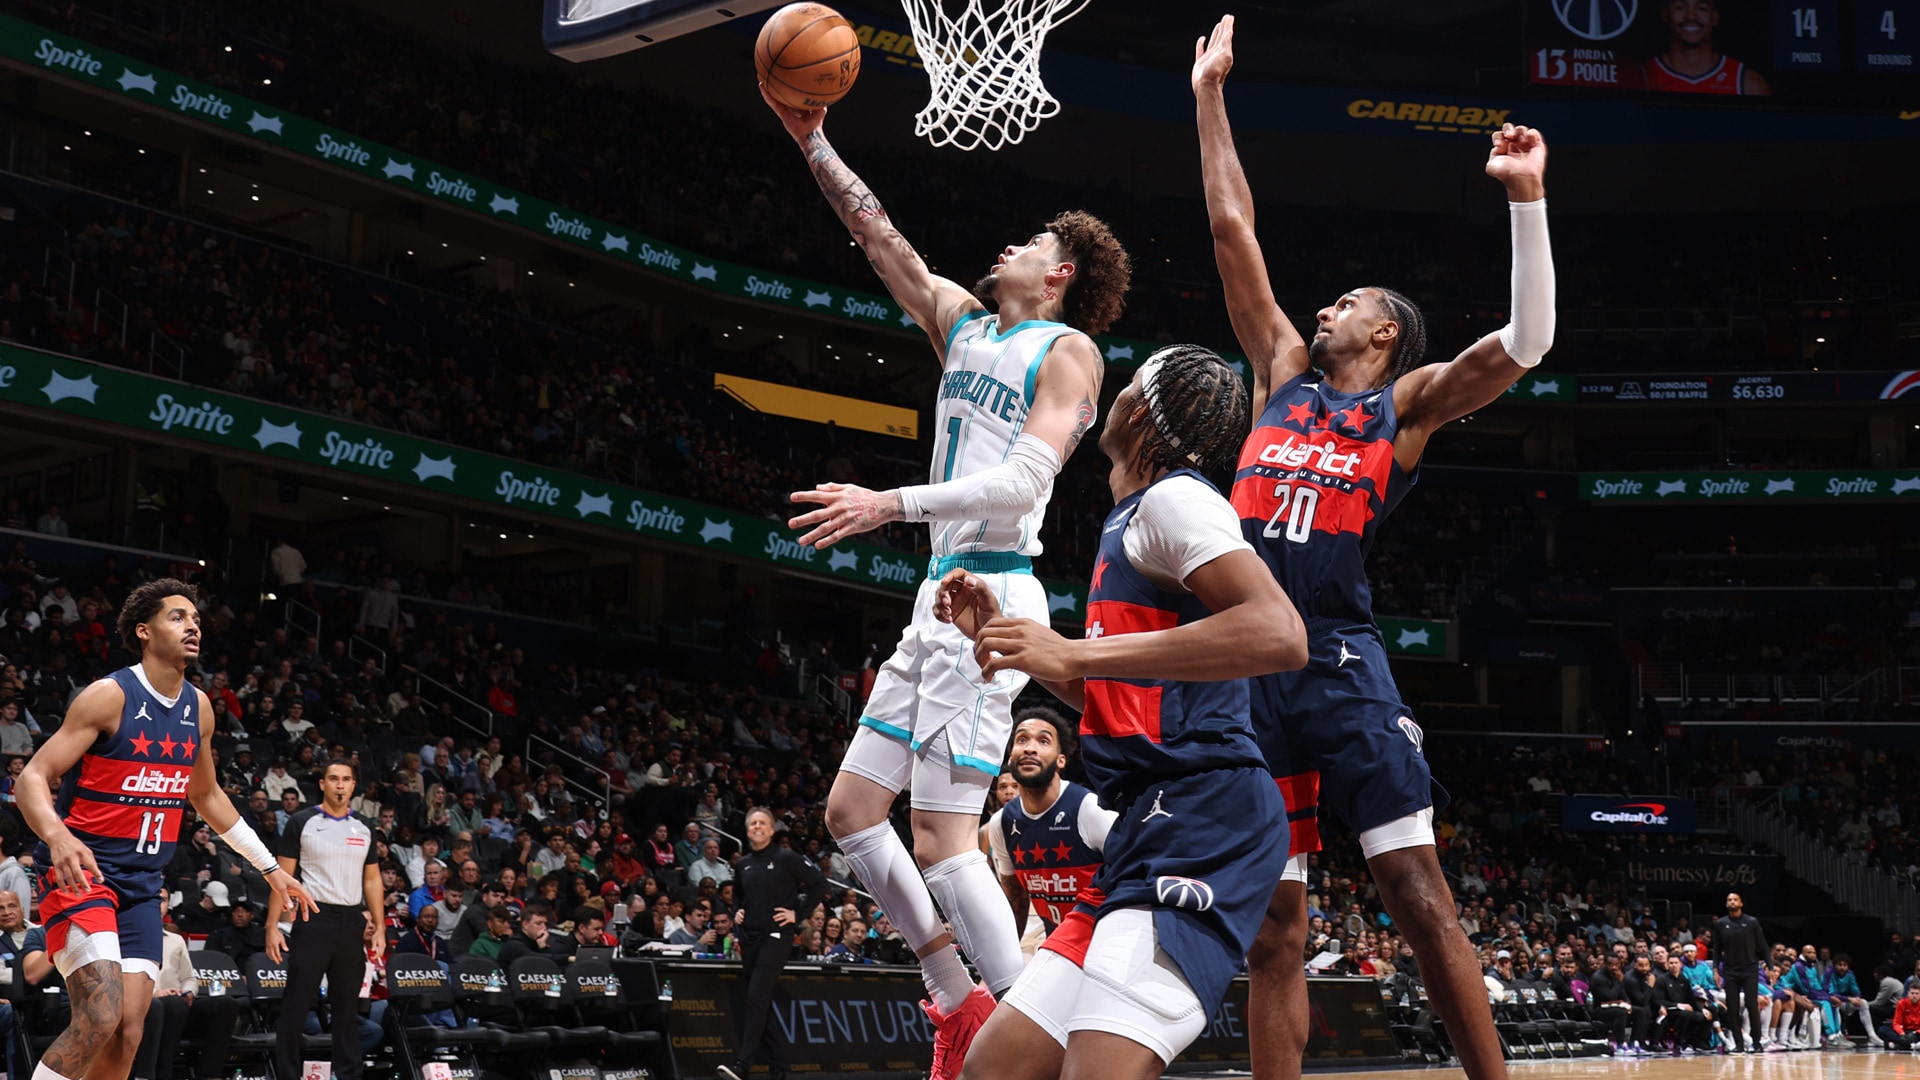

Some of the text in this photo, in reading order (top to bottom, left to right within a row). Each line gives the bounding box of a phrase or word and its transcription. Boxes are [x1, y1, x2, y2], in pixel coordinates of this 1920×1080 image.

[1792, 8, 1819, 38] 14
[1880, 10, 1897, 40] 4
[34, 38, 102, 76] Sprite
[1536, 48, 1568, 80] 13
[1573, 48, 1615, 60] JORDAN
[1792, 51, 1823, 63] POINTS
[1867, 53, 1912, 66] REBOUNDS
[1573, 64, 1618, 83] POOLE
[171, 85, 232, 120] Sprite
[315, 133, 370, 166] Sprite
[426, 171, 477, 202] Sprite
[545, 211, 592, 241] Sprite
[638, 243, 681, 271] Sprite
[743, 275, 793, 300] Sprite
[842, 296, 888, 320] Sprite
[940, 370, 1019, 423] CHARLOTTE
[1650, 381, 1707, 389] FOUNDATION
[1679, 390, 1708, 399] RAFFLE
[1732, 385, 1784, 400] $6,630
[149, 393, 234, 430] Sprite
[319, 430, 394, 470] Sprite
[943, 416, 962, 482] 1
[495, 470, 561, 506] Sprite
[1592, 479, 1643, 498] Sprite
[1699, 478, 1750, 498] Sprite
[1825, 477, 1878, 497] Sprite
[626, 500, 685, 533] Sprite
[1262, 483, 1318, 544] 20
[868, 554, 916, 584] Sprite
[121, 765, 191, 793] district
[136, 811, 165, 855] 13
[1628, 861, 1758, 886] Hennessy Lofts
[1047, 904, 1061, 926] 0
[193, 968, 240, 981] AESARS
[257, 969, 288, 981] CAES
[394, 969, 447, 981] CAESARS
[396, 980, 442, 989] SPORTSBOOK
[671, 999, 717, 1011] ARmax
[771, 998, 935, 1044] VENTURE
[561, 1068, 596, 1077] CAESARS
[616, 1068, 649, 1080] CAESARS
